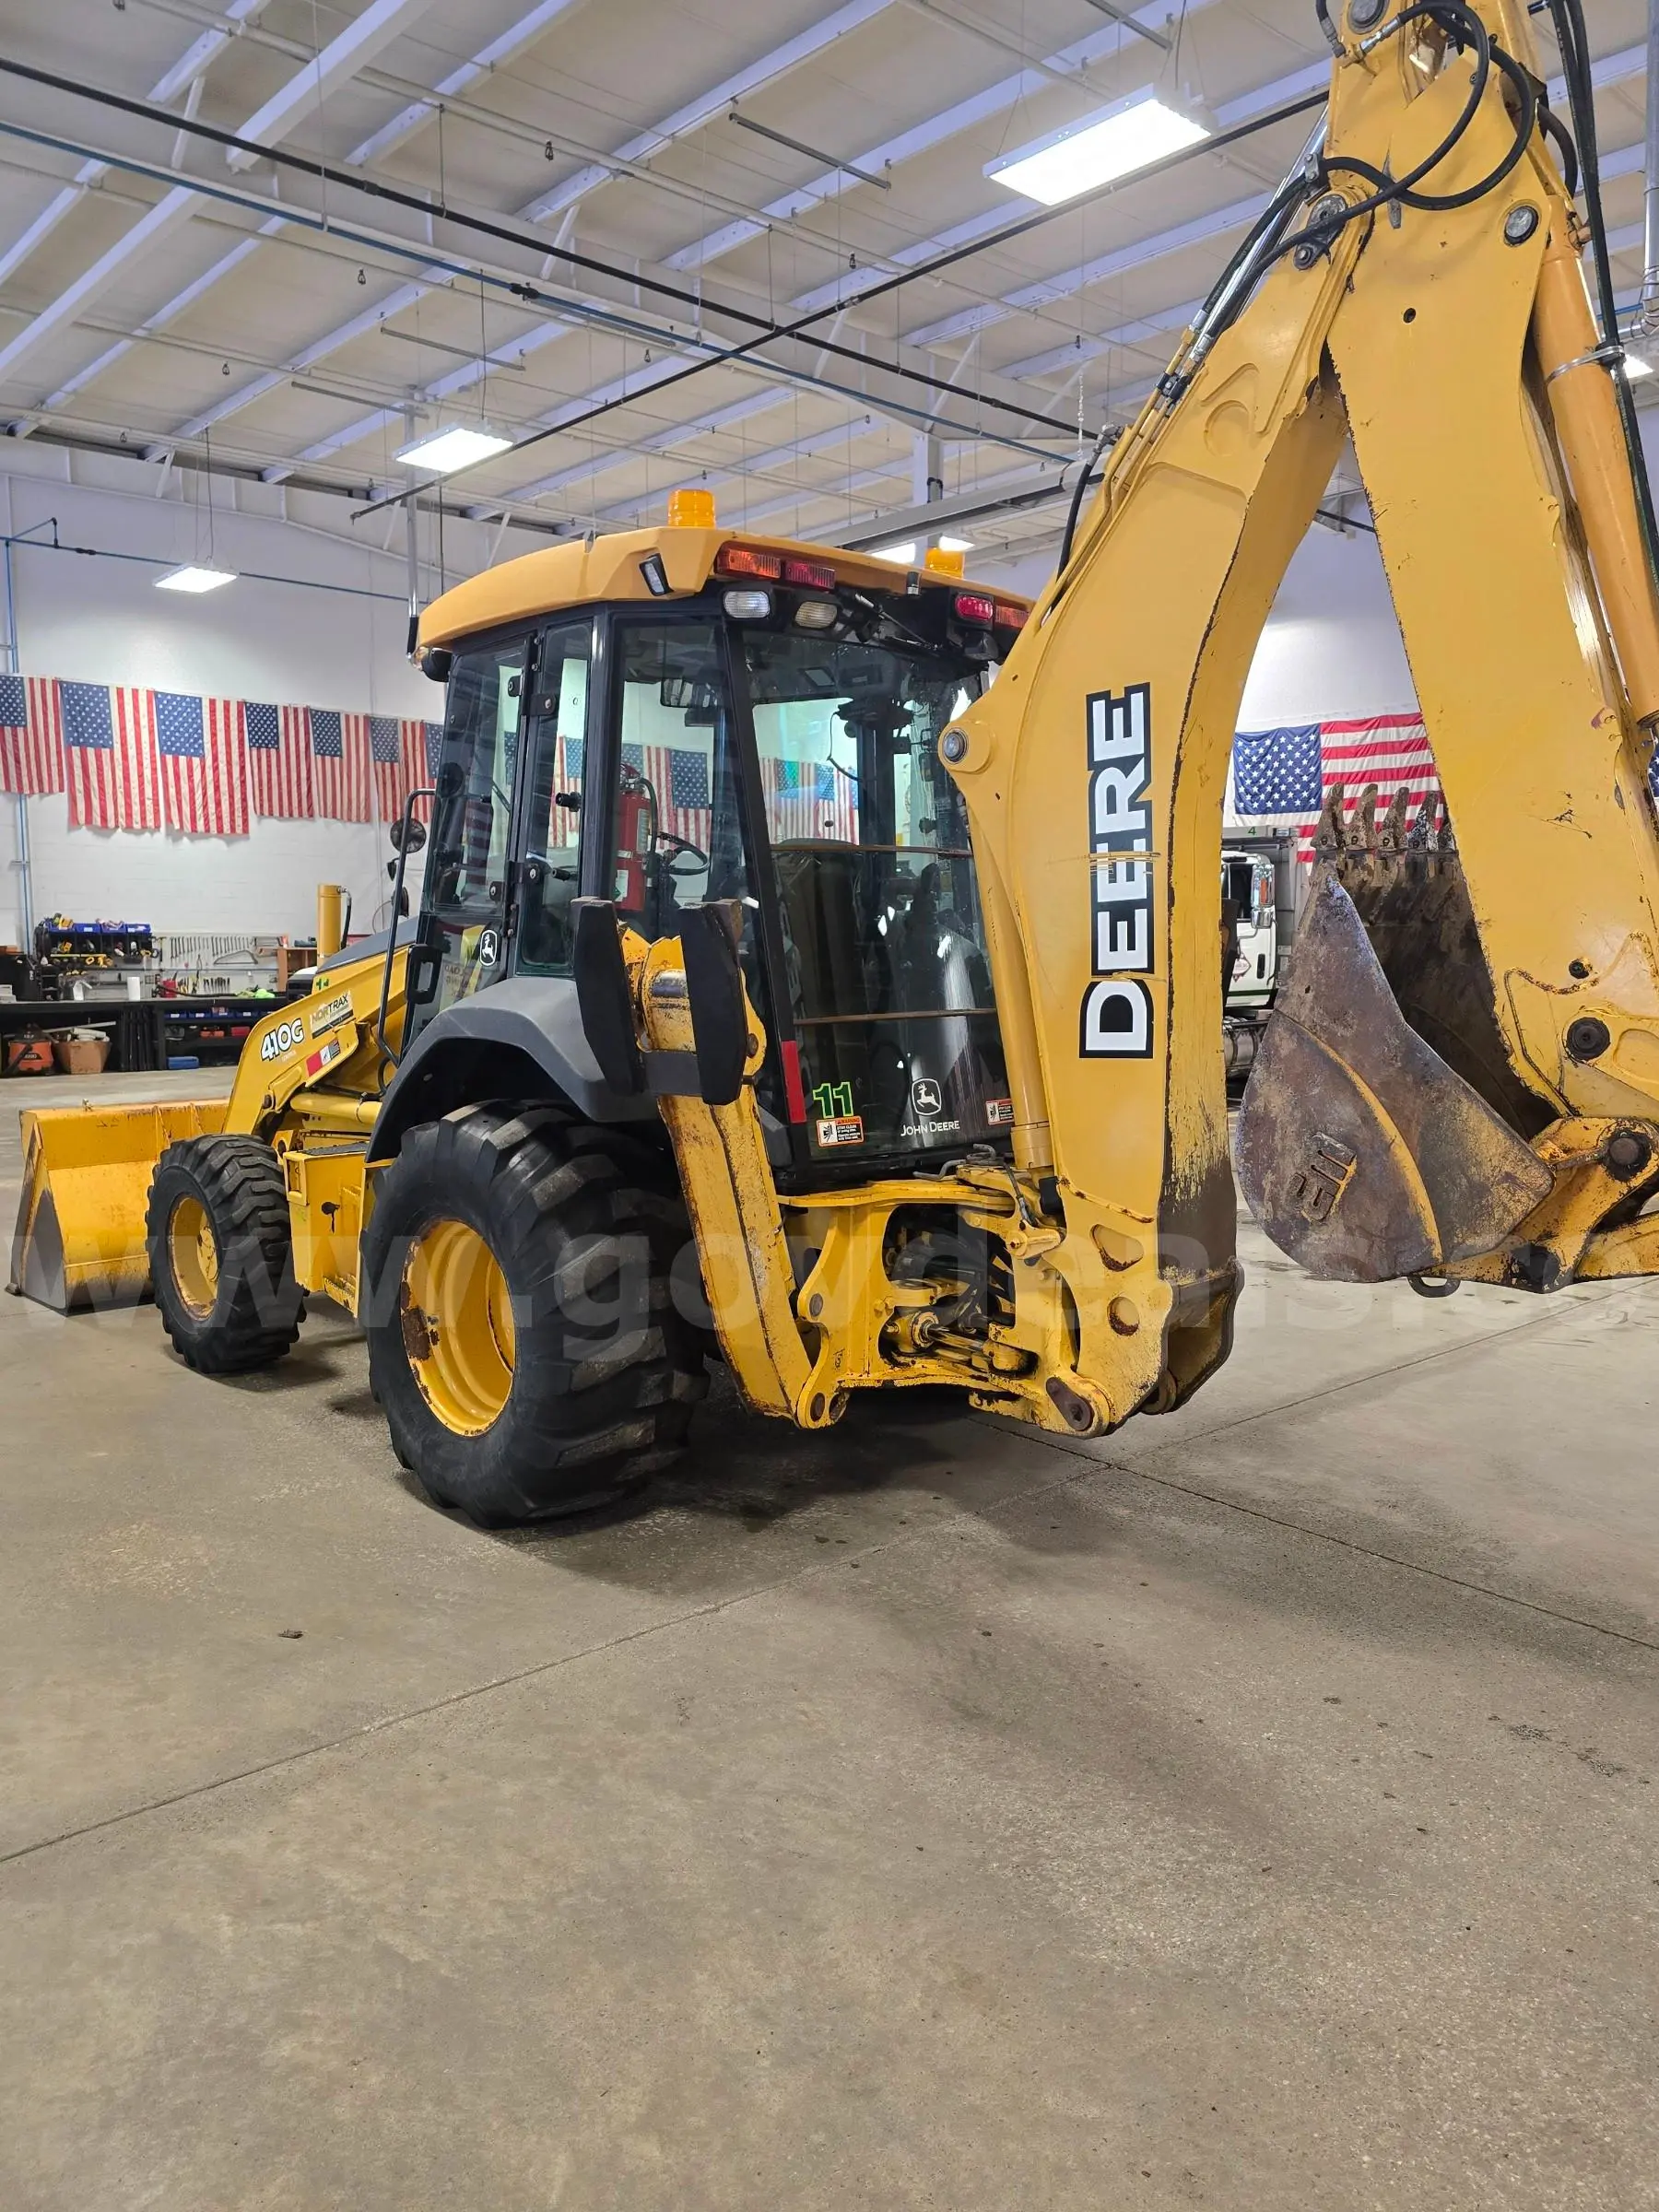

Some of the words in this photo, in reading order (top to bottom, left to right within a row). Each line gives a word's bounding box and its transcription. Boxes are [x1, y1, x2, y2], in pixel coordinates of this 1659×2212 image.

[1247, 826, 1257, 836] 4
[1082, 687, 1151, 1055] DEERE
[261, 1018, 305, 1062] 410G
[813, 1082, 853, 1119] 11
[900, 1124, 927, 1136] JOHN
[929, 1121, 960, 1133] DEERE
